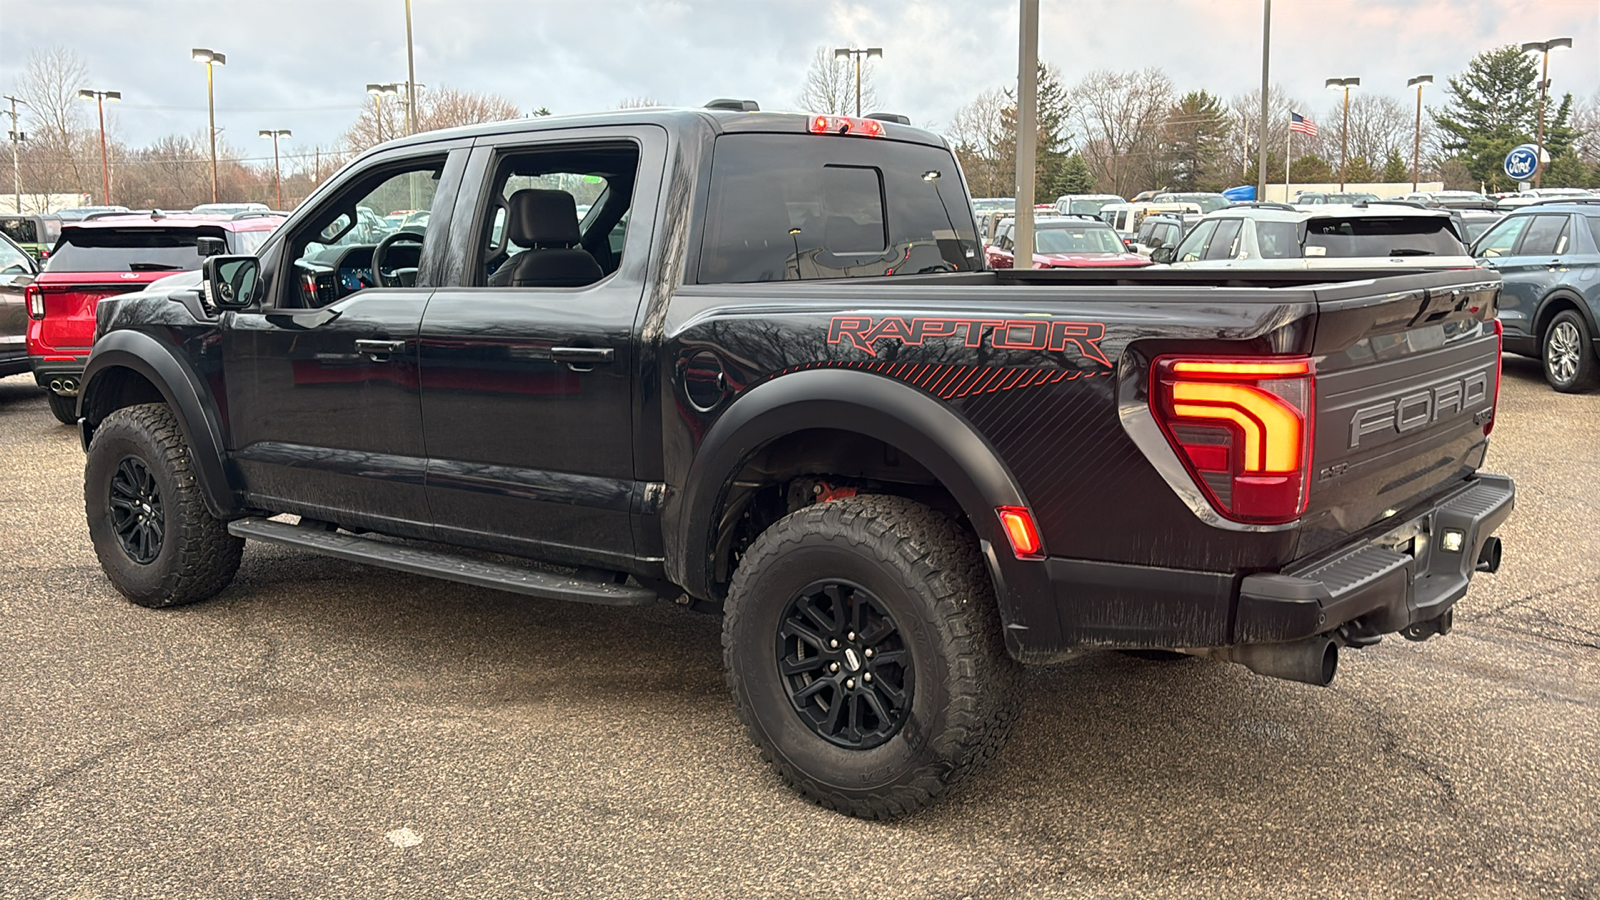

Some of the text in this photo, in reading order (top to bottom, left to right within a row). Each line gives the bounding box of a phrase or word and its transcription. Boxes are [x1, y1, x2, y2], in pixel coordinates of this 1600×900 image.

[1509, 153, 1532, 174] Ford
[827, 316, 1113, 368] RAPTOR
[1349, 371, 1487, 449] FORD
